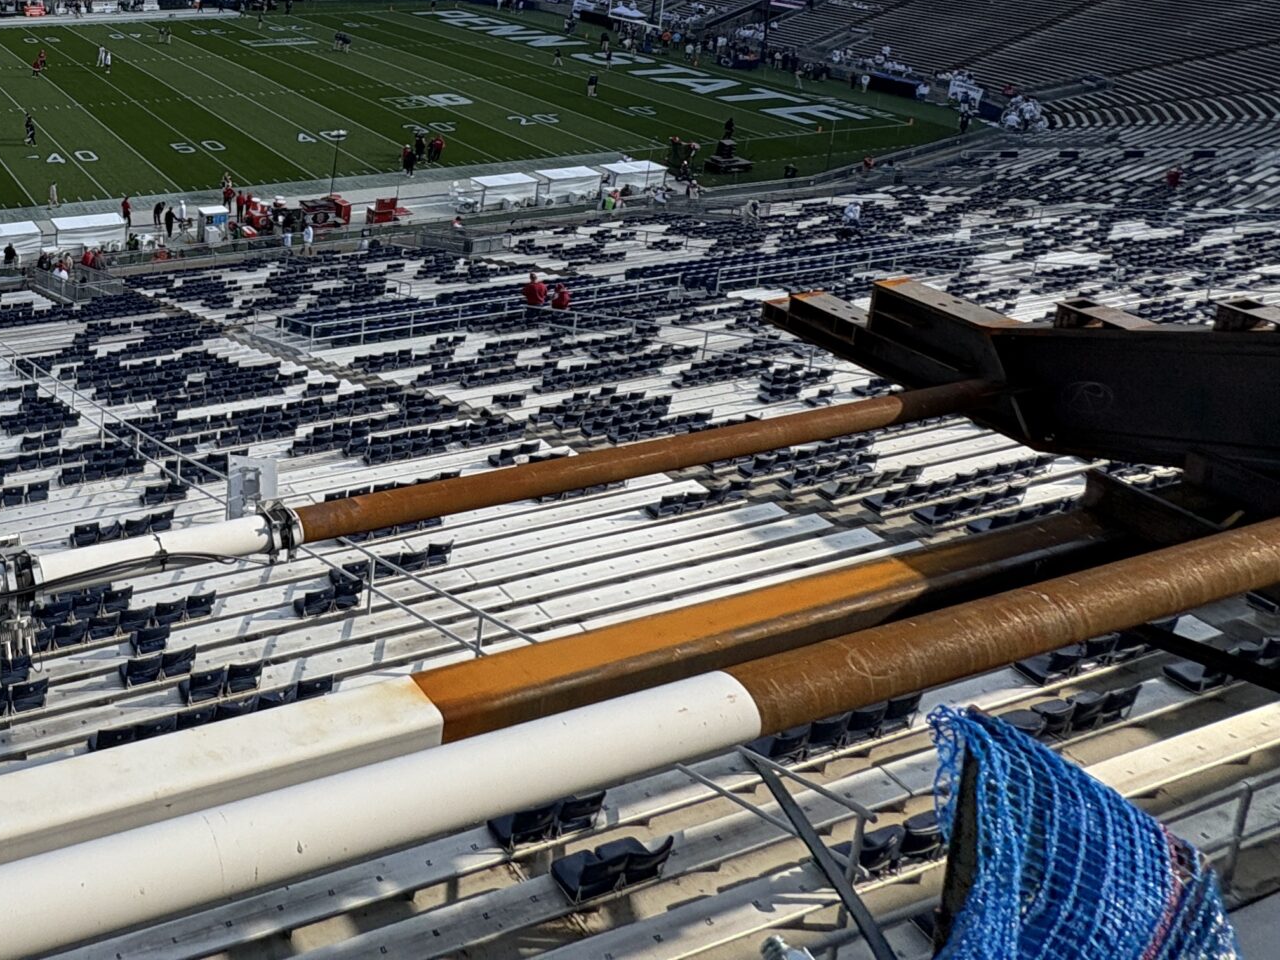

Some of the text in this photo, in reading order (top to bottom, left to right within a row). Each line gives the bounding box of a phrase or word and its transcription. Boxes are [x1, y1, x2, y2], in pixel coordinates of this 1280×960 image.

[412, 9, 590, 48] PENN
[570, 51, 871, 125] STATE
[169, 140, 227, 155] 50
[46, 148, 100, 165] 40
